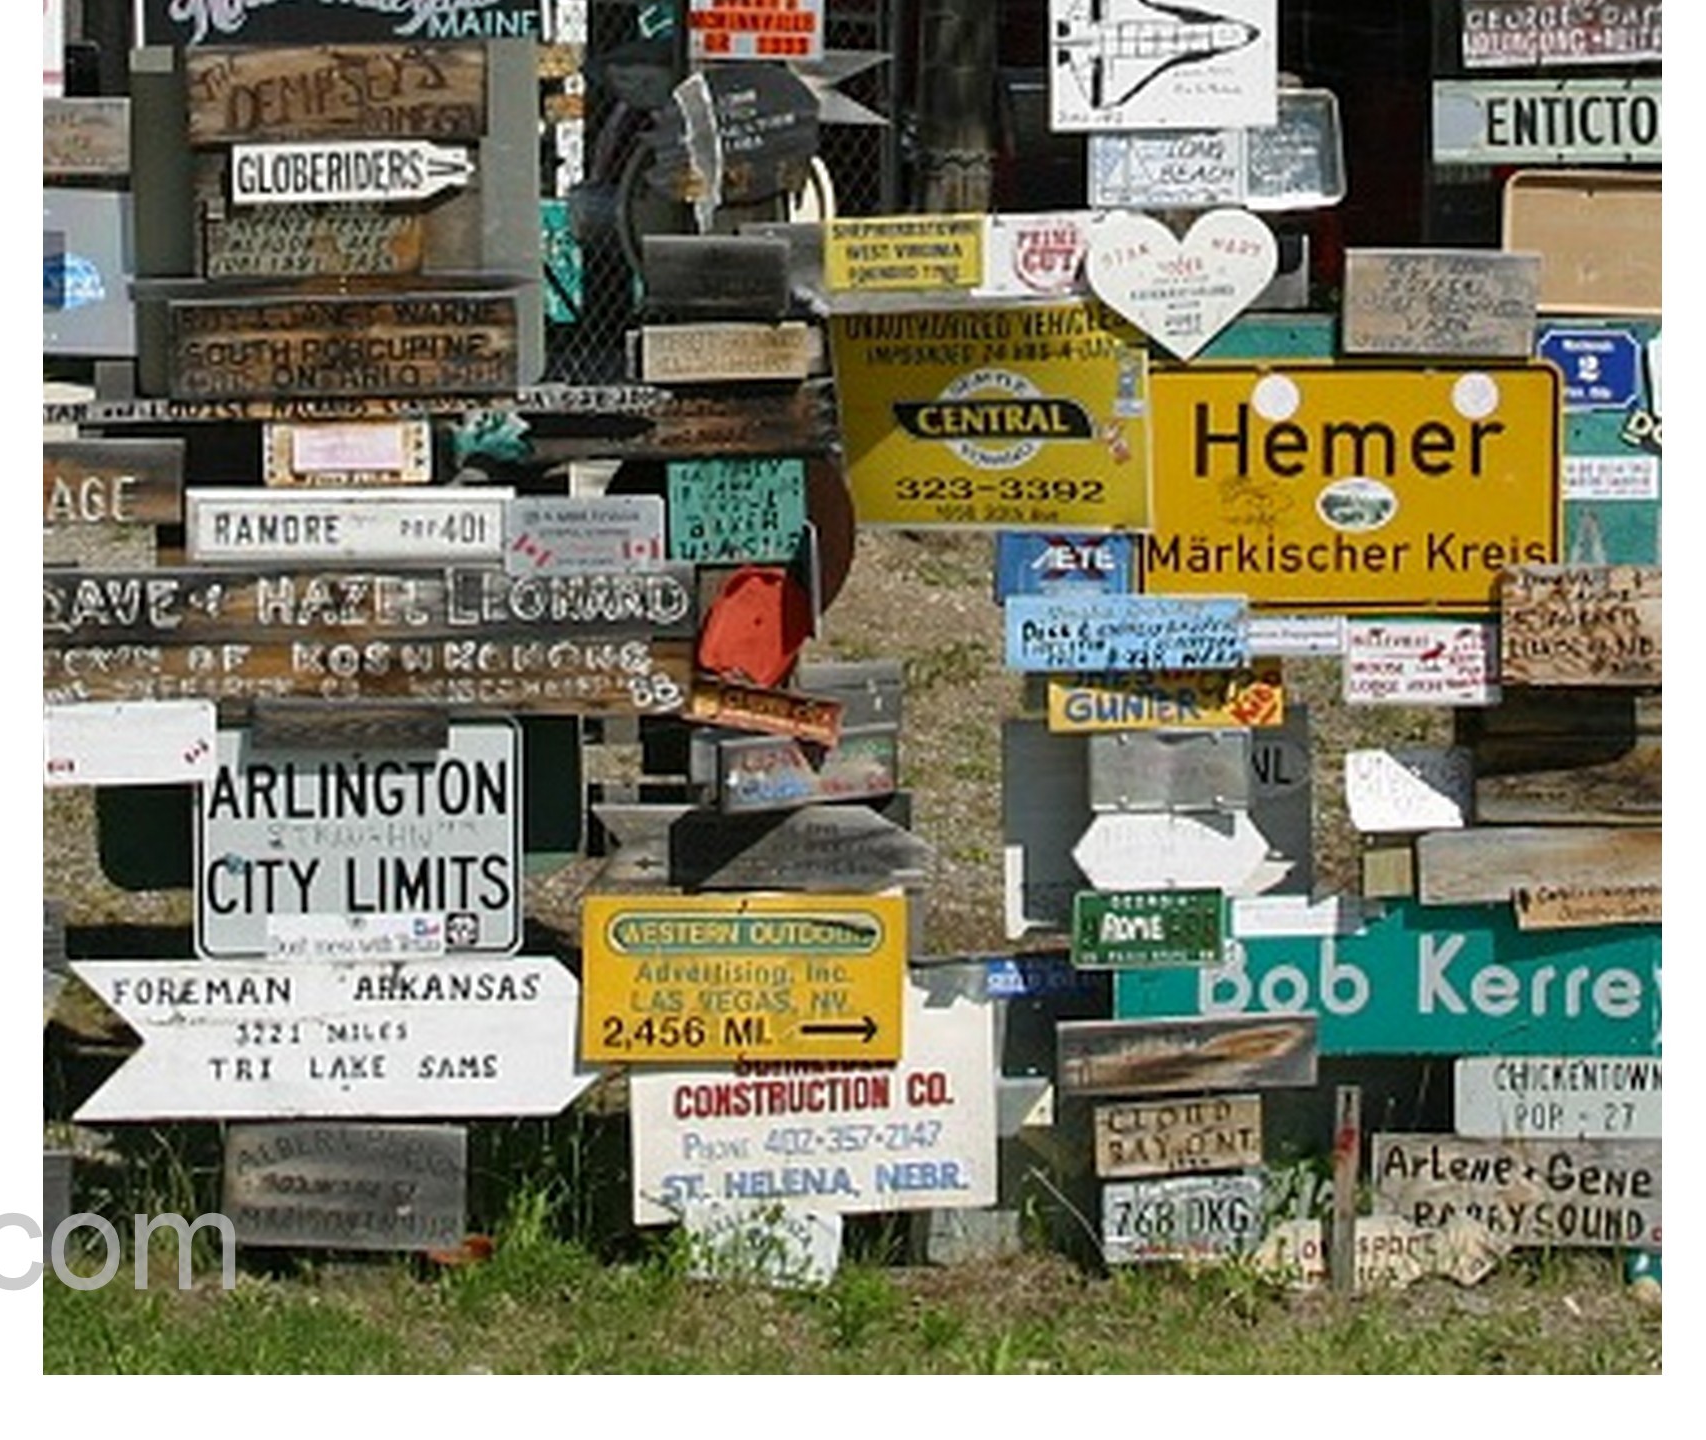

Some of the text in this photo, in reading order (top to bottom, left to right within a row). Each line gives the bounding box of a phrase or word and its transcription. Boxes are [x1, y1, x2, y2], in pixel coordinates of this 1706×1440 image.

[427, 8, 539, 39] MAINE
[236, 146, 425, 195] GLOBERIDERS
[846, 243, 963, 260] WEST VIRGINIA
[916, 405, 1070, 435] CENTRAL
[1194, 403, 1504, 477] Hemer
[894, 476, 1105, 503] 323-3392
[214, 513, 341, 544] RAMORE
[440, 514, 487, 544] 401
[1148, 533, 1546, 573] Märkischer Kreis
[208, 759, 508, 820] ARLINGTON
[207, 855, 511, 915] CITY LIMITS
[624, 921, 740, 944] WESTERN
[112, 974, 541, 1006] FOREMAN ARKANSAS
[1198, 935, 1371, 1015] Bob
[630, 991, 683, 1012] LAS
[327, 1022, 409, 1044] MILES
[603, 1015, 705, 1050] 2,456
[209, 1055, 498, 1081] TRI LAKE SAMS
[673, 1072, 955, 1119] CONSTRUCTION CO.
[1603, 1103, 1635, 1129] 27
[1546, 1153, 1654, 1199] Gene
